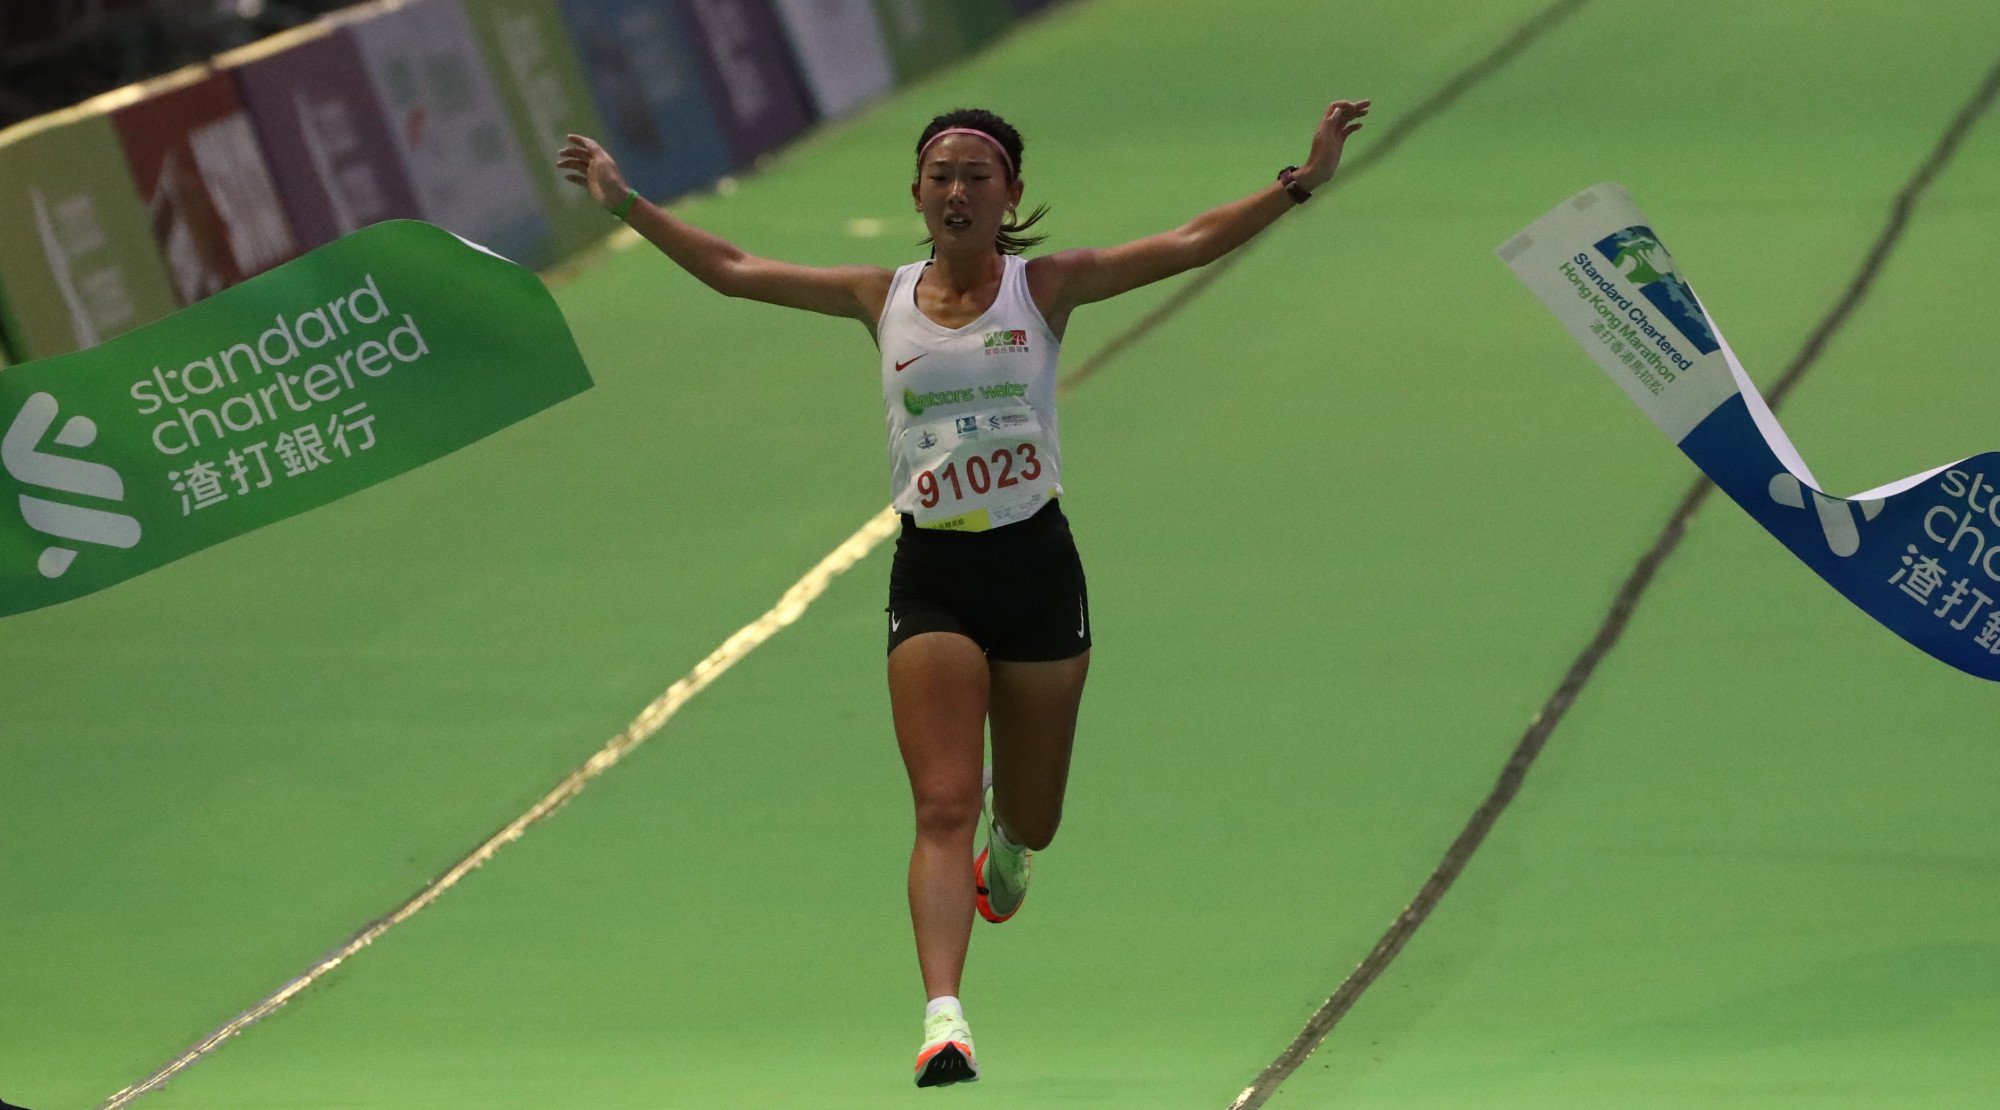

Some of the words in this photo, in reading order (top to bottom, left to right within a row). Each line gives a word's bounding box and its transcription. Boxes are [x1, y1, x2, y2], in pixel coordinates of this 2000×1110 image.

[130, 272, 390, 415] standard
[1559, 261, 1592, 299] Hong
[1588, 294, 1622, 330] Kong
[1618, 322, 1677, 384] Marathon
[1573, 252, 1633, 311] Standard
[1628, 307, 1694, 371] Chartered
[152, 313, 431, 455] chartered
[167, 401, 377, 517] 渣打銀行
[917, 442, 1042, 509] 91023
